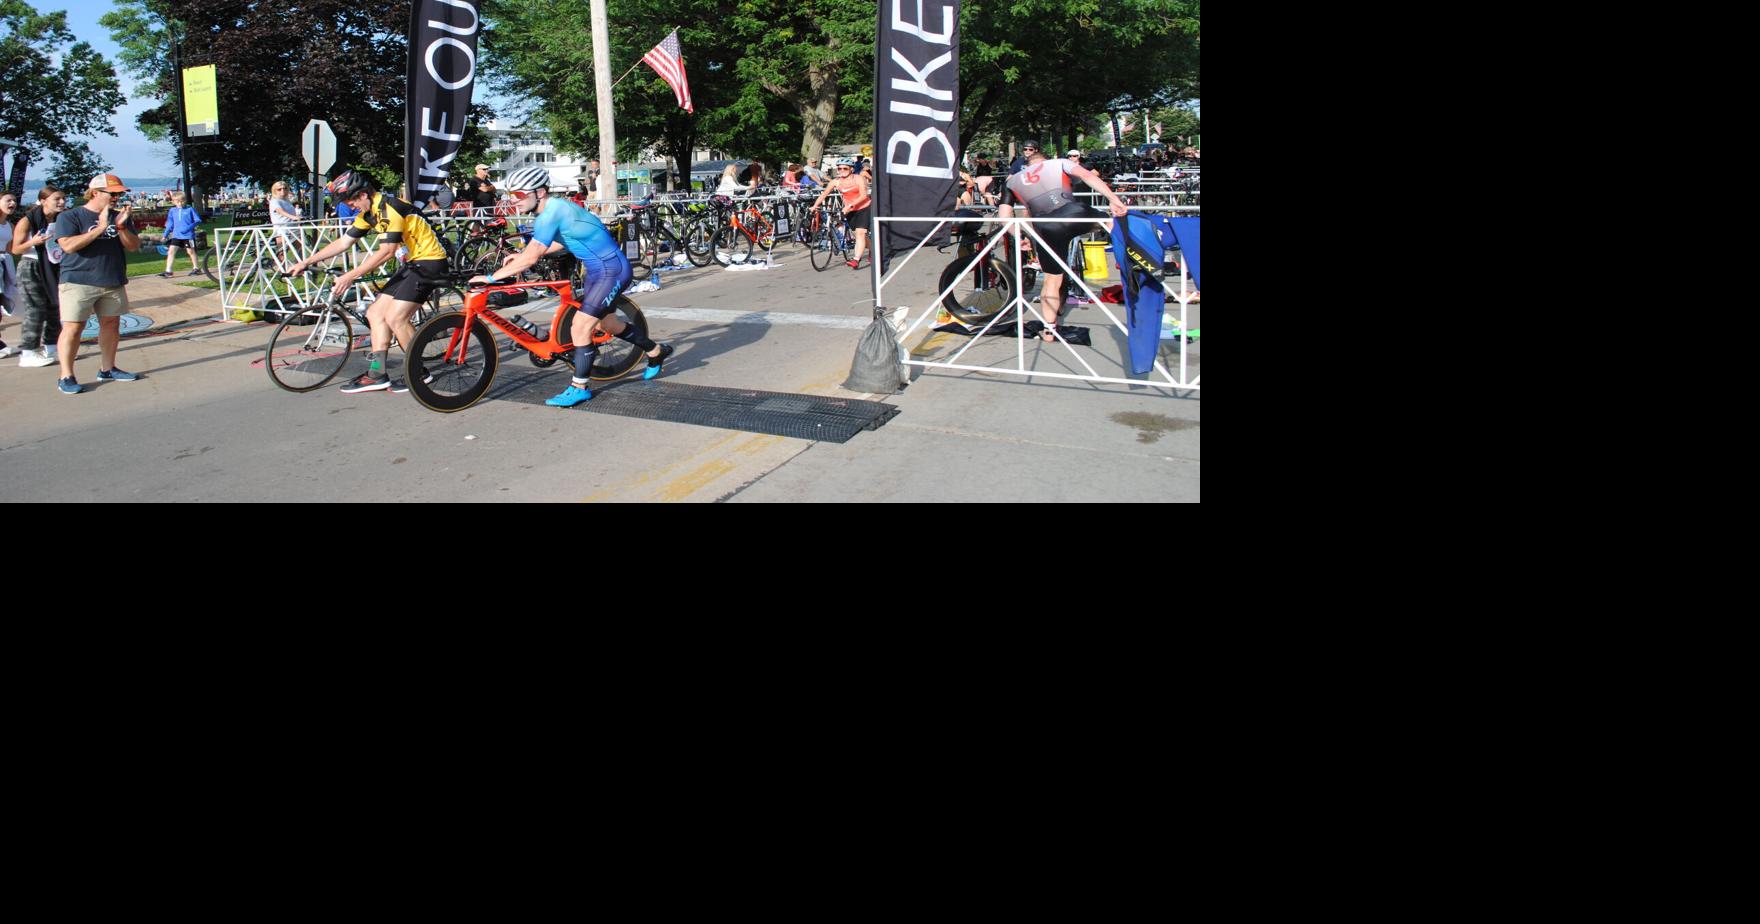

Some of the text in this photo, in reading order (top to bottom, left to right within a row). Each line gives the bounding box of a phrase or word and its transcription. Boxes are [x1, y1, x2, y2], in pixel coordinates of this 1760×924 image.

[886, 0, 956, 179] BIKE
[235, 210, 270, 219] Free Conc
